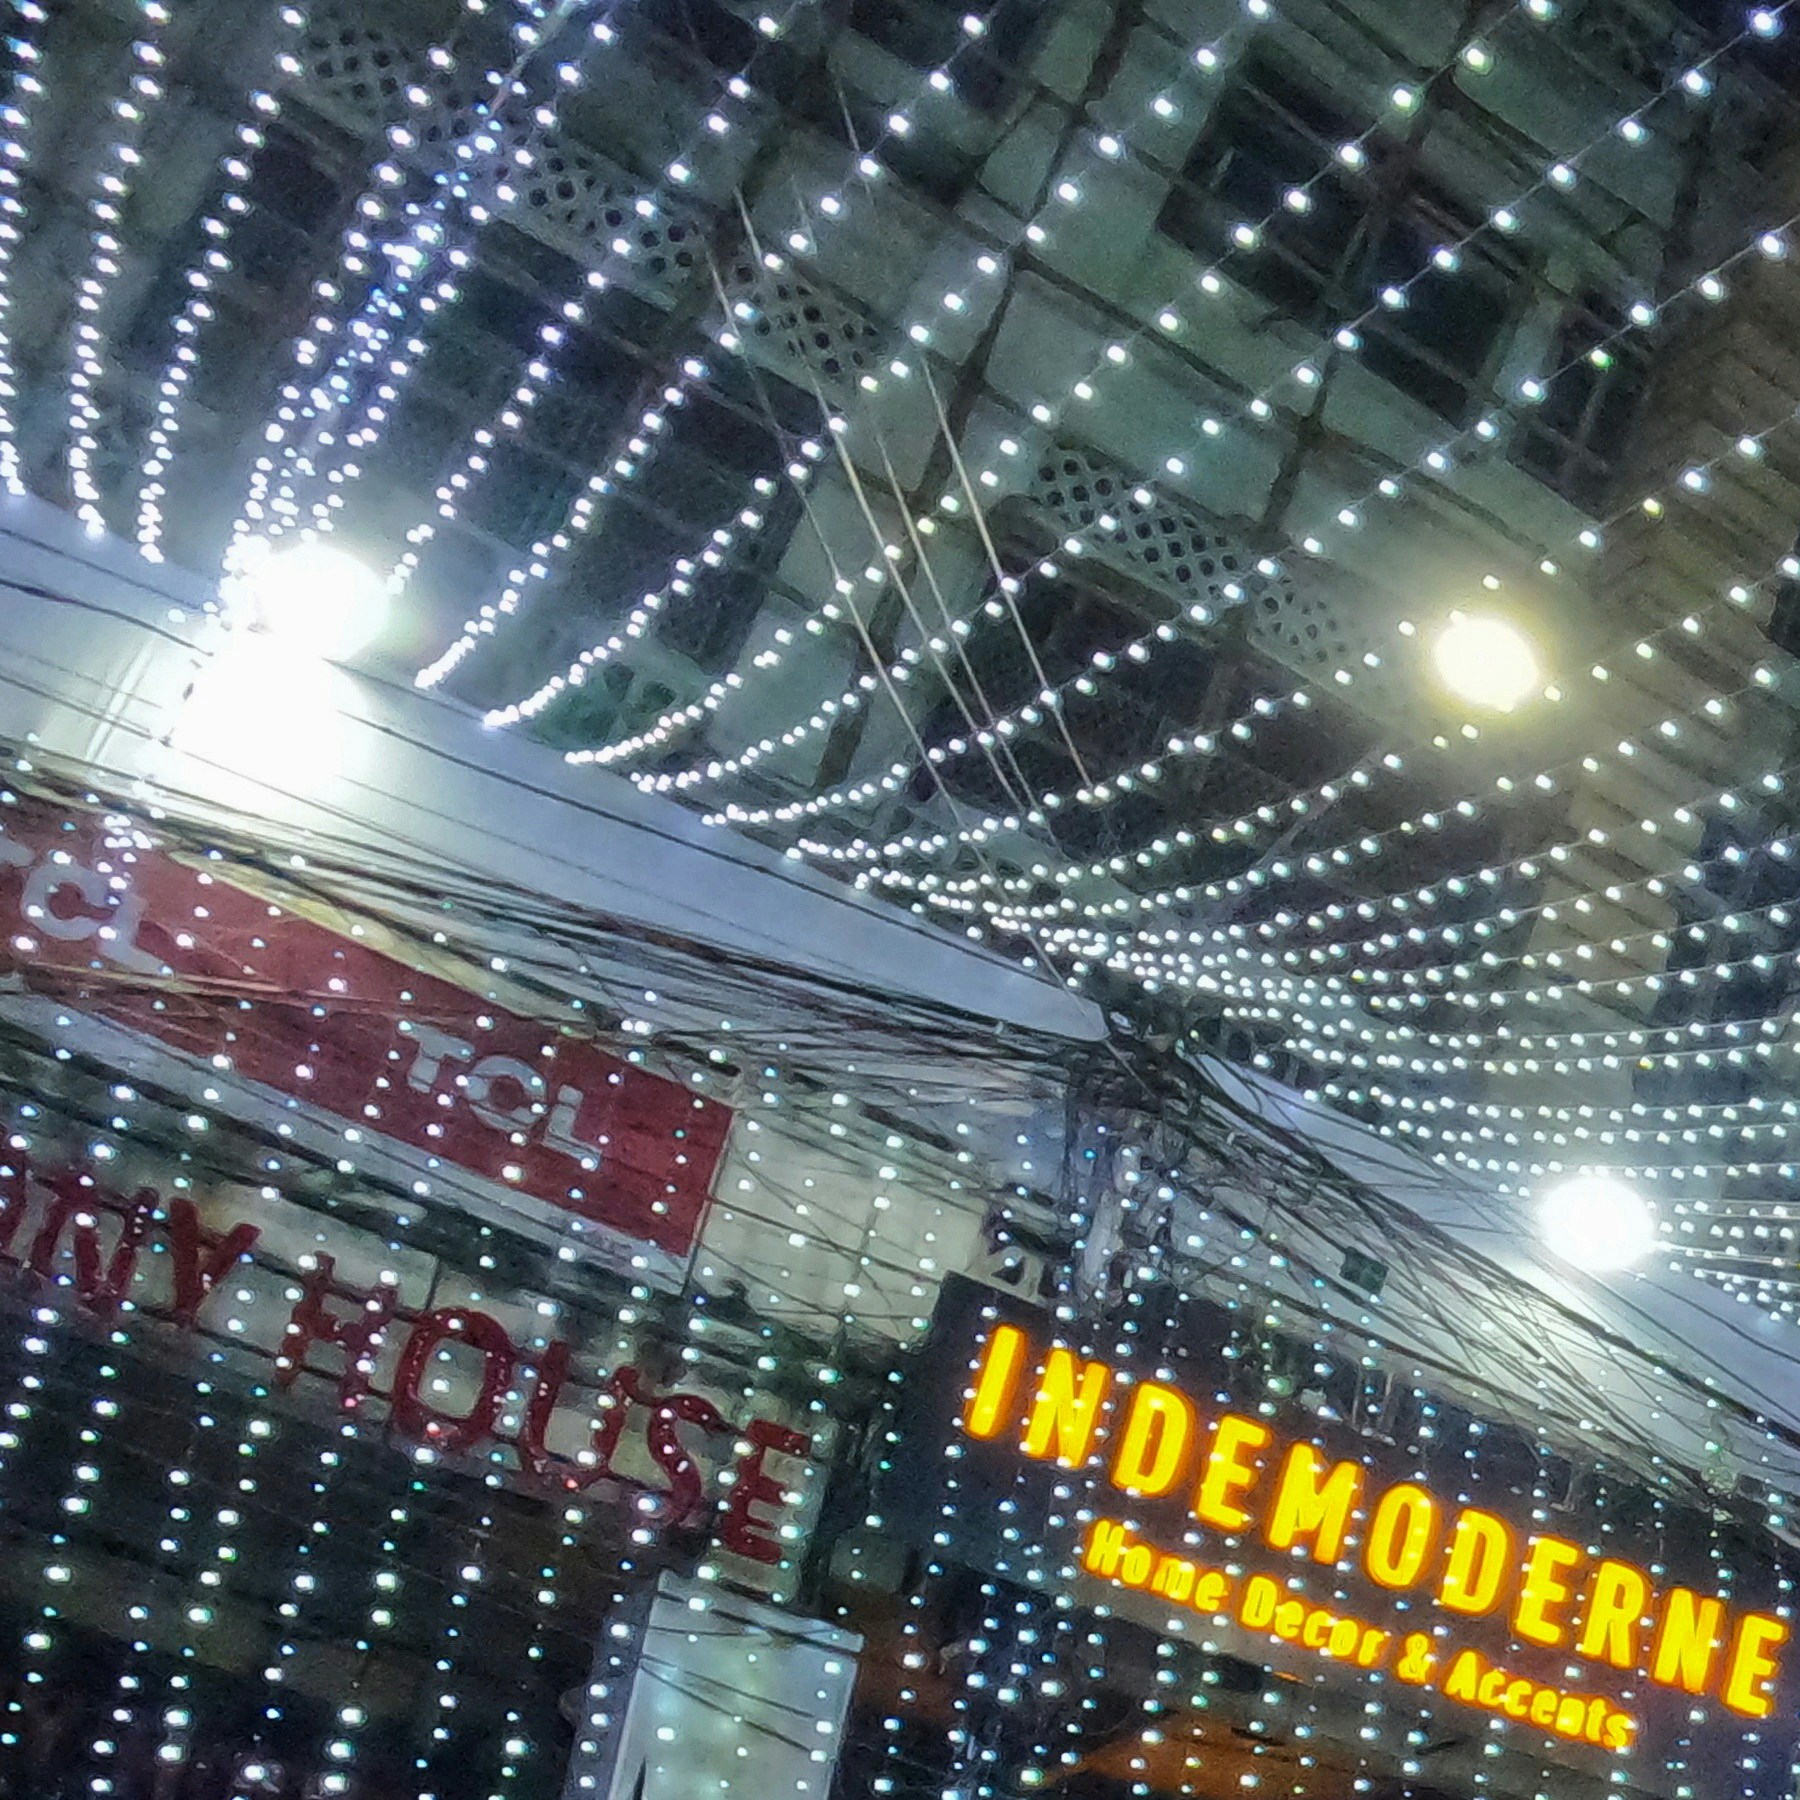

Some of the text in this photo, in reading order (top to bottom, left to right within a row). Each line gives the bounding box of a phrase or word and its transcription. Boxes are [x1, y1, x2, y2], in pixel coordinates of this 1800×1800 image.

[0, 830, 172, 976] CL
[396, 1019, 604, 1168] TCL
[0, 1120, 811, 1566] NY HOUSE
[964, 1324, 1790, 1718] INDEMODERNE
[1083, 1518, 1639, 1753] Home Decor & Accents
